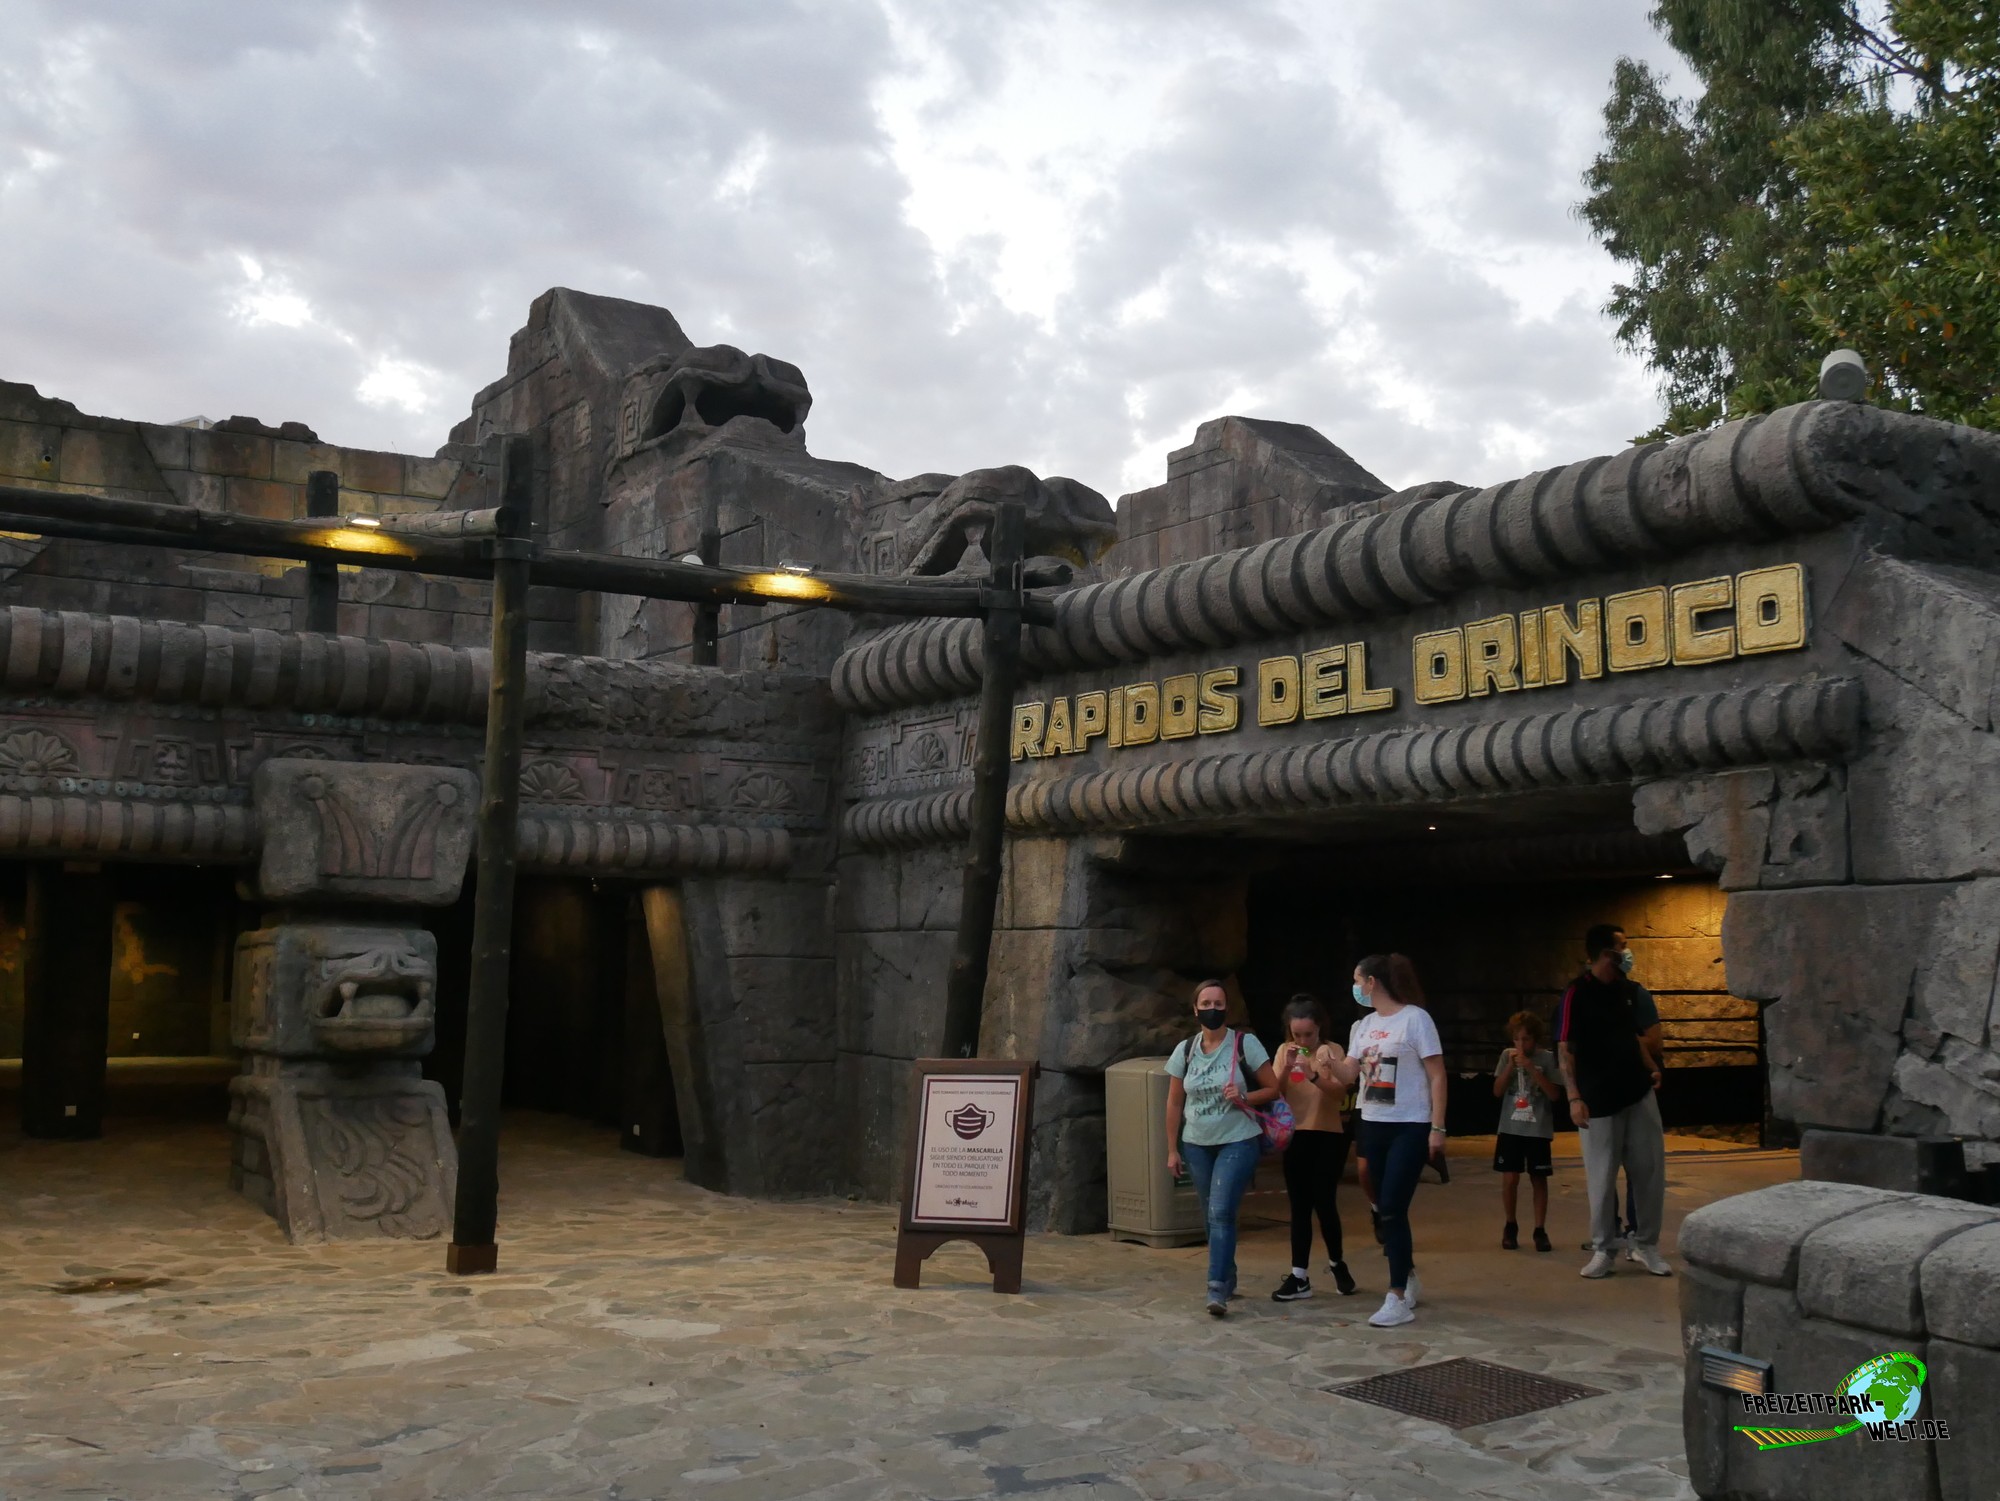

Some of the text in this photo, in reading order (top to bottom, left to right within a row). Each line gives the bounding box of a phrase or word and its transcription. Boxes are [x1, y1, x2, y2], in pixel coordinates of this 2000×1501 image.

[1010, 562, 1807, 762] RAPIDOS DEL ORINOCO
